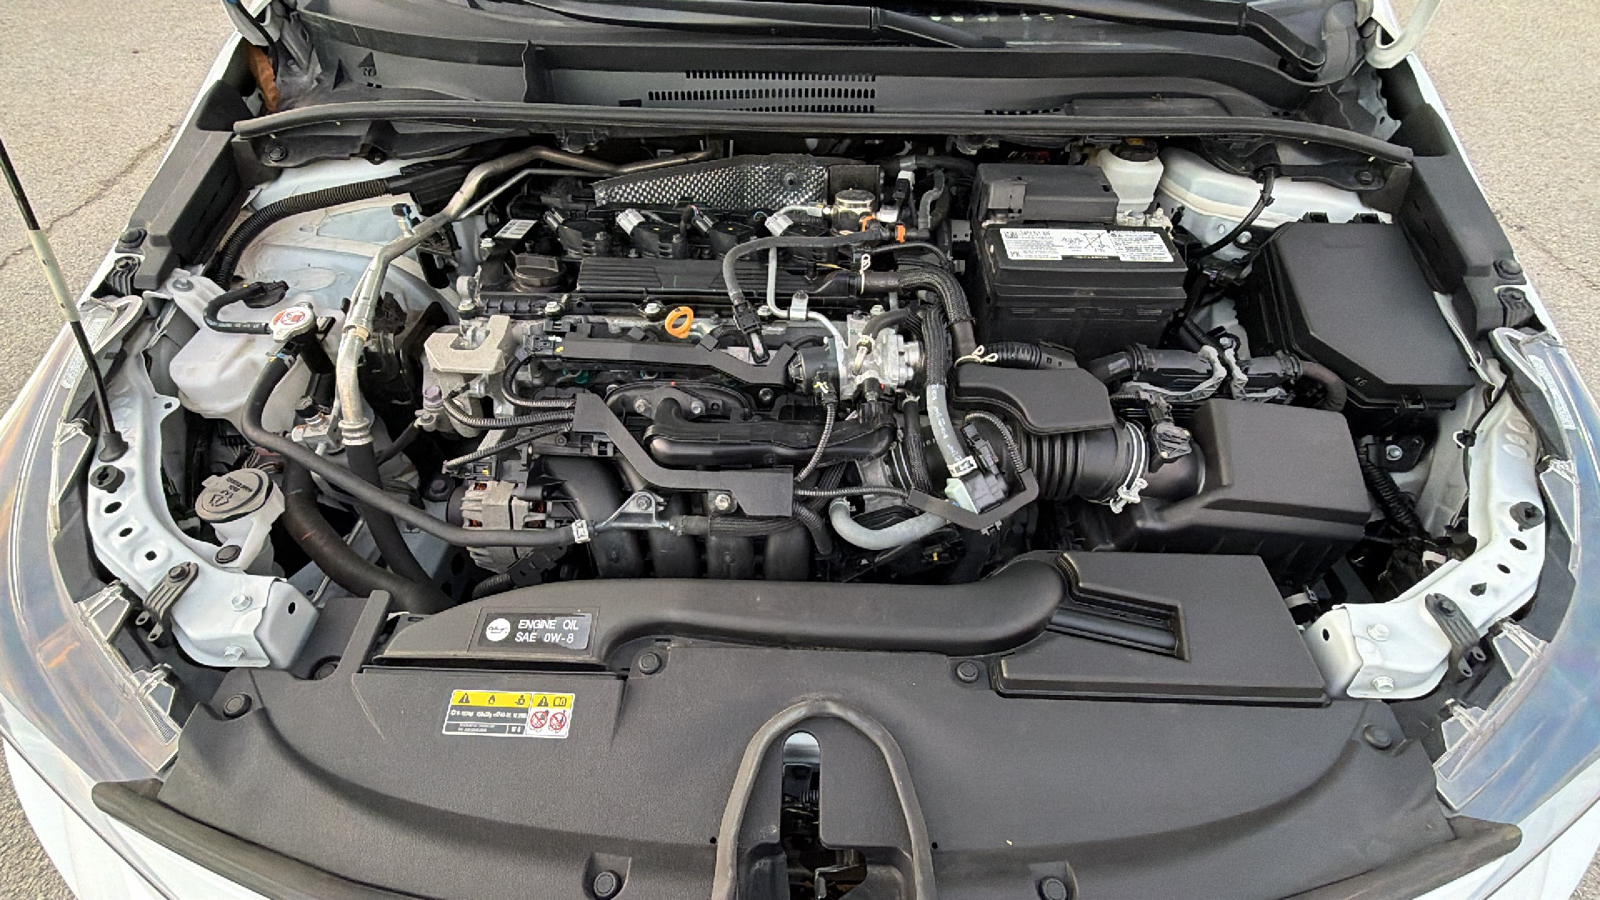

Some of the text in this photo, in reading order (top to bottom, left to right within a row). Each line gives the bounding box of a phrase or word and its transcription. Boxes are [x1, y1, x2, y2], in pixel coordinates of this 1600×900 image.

[518, 619, 579, 630] ENGINE OIL
[515, 632, 574, 643] SAE 0W-8
